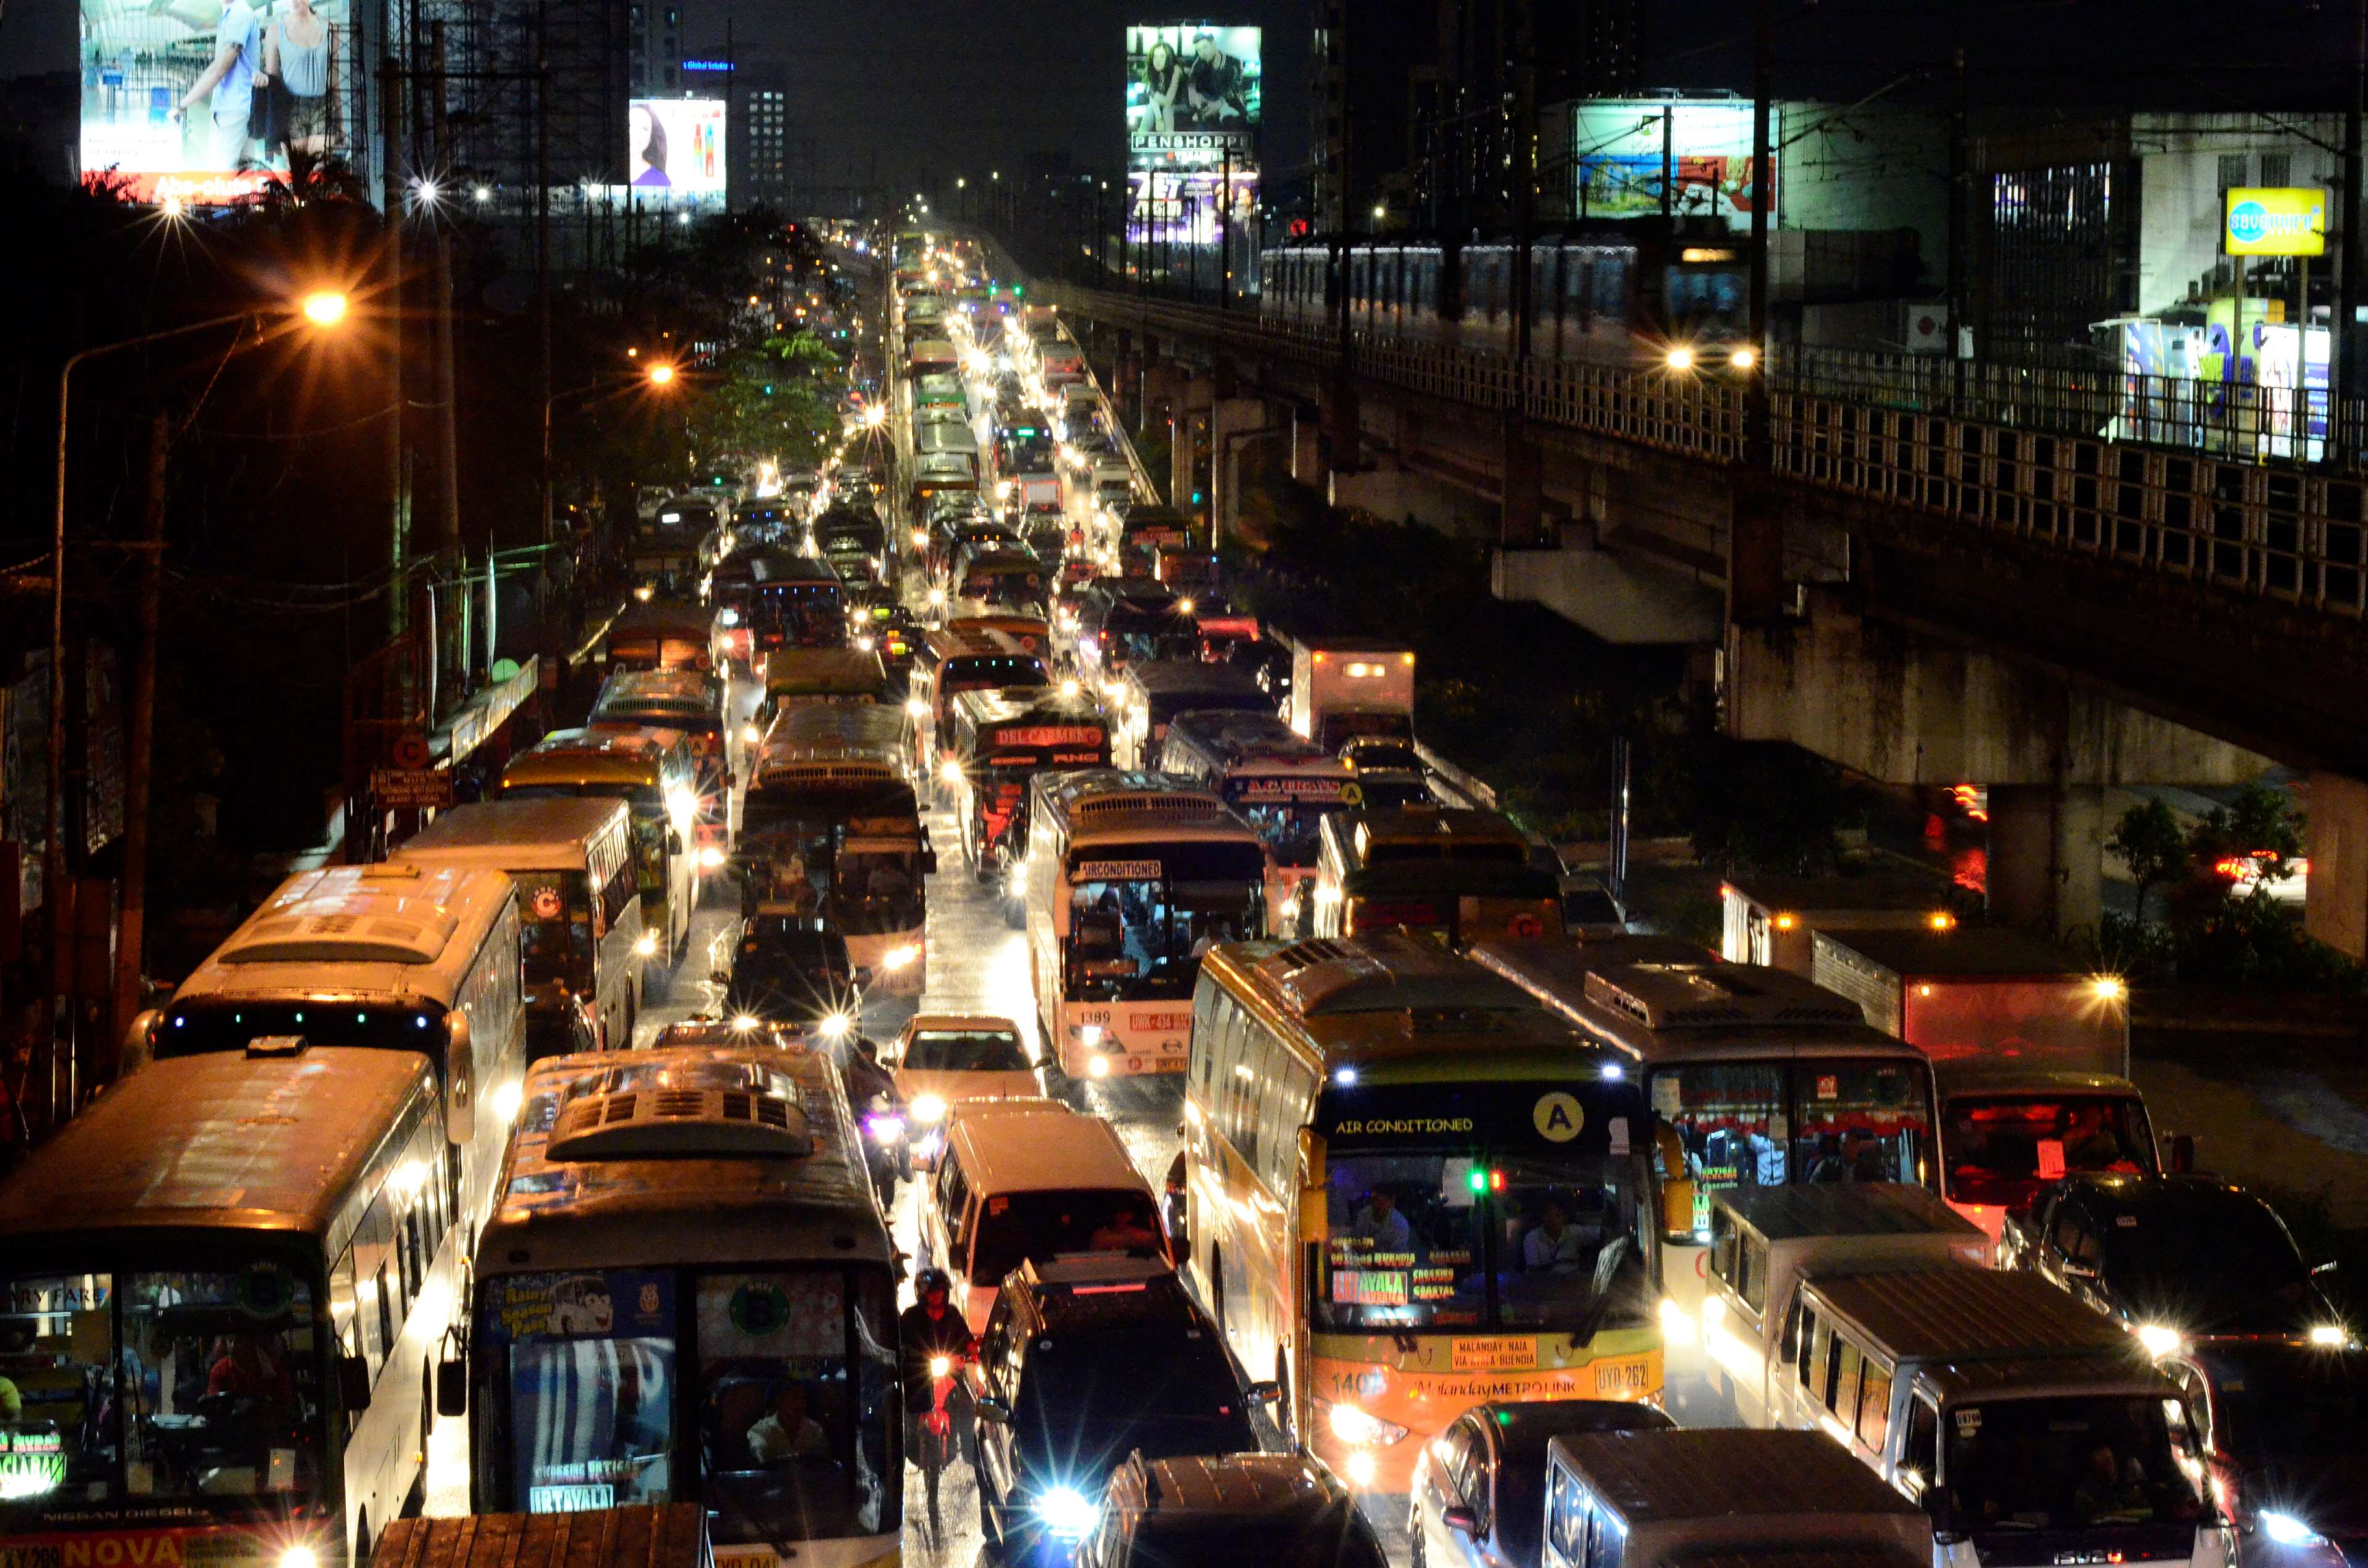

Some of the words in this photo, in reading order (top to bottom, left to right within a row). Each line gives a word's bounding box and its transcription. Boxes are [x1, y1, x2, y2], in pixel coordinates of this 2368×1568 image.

[999, 731, 1023, 745] DEL
[1029, 728, 1084, 745] CARMEN
[1282, 779, 1339, 794] TRANS
[1346, 788, 1357, 802] A
[1083, 861, 1160, 876] AIRCONDITIONED
[536, 893, 556, 911] C
[1081, 1011, 1111, 1024] 1389
[1547, 1104, 1572, 1130] A
[1335, 1121, 1363, 1134] AIR
[1366, 1118, 1473, 1134] CONDITIONED
[1459, 1342, 1503, 1353] MALANDAY
[1509, 1341, 1528, 1352] NAIA
[1454, 1355, 1467, 1366] VIA
[1499, 1355, 1534, 1365] BUENDIA
[563, 1487, 609, 1513] AYALA
[43, 1511, 119, 1522] NISSAN
[125, 1506, 197, 1519] DIESEL
[64, 1538, 180, 1567] NOVA
